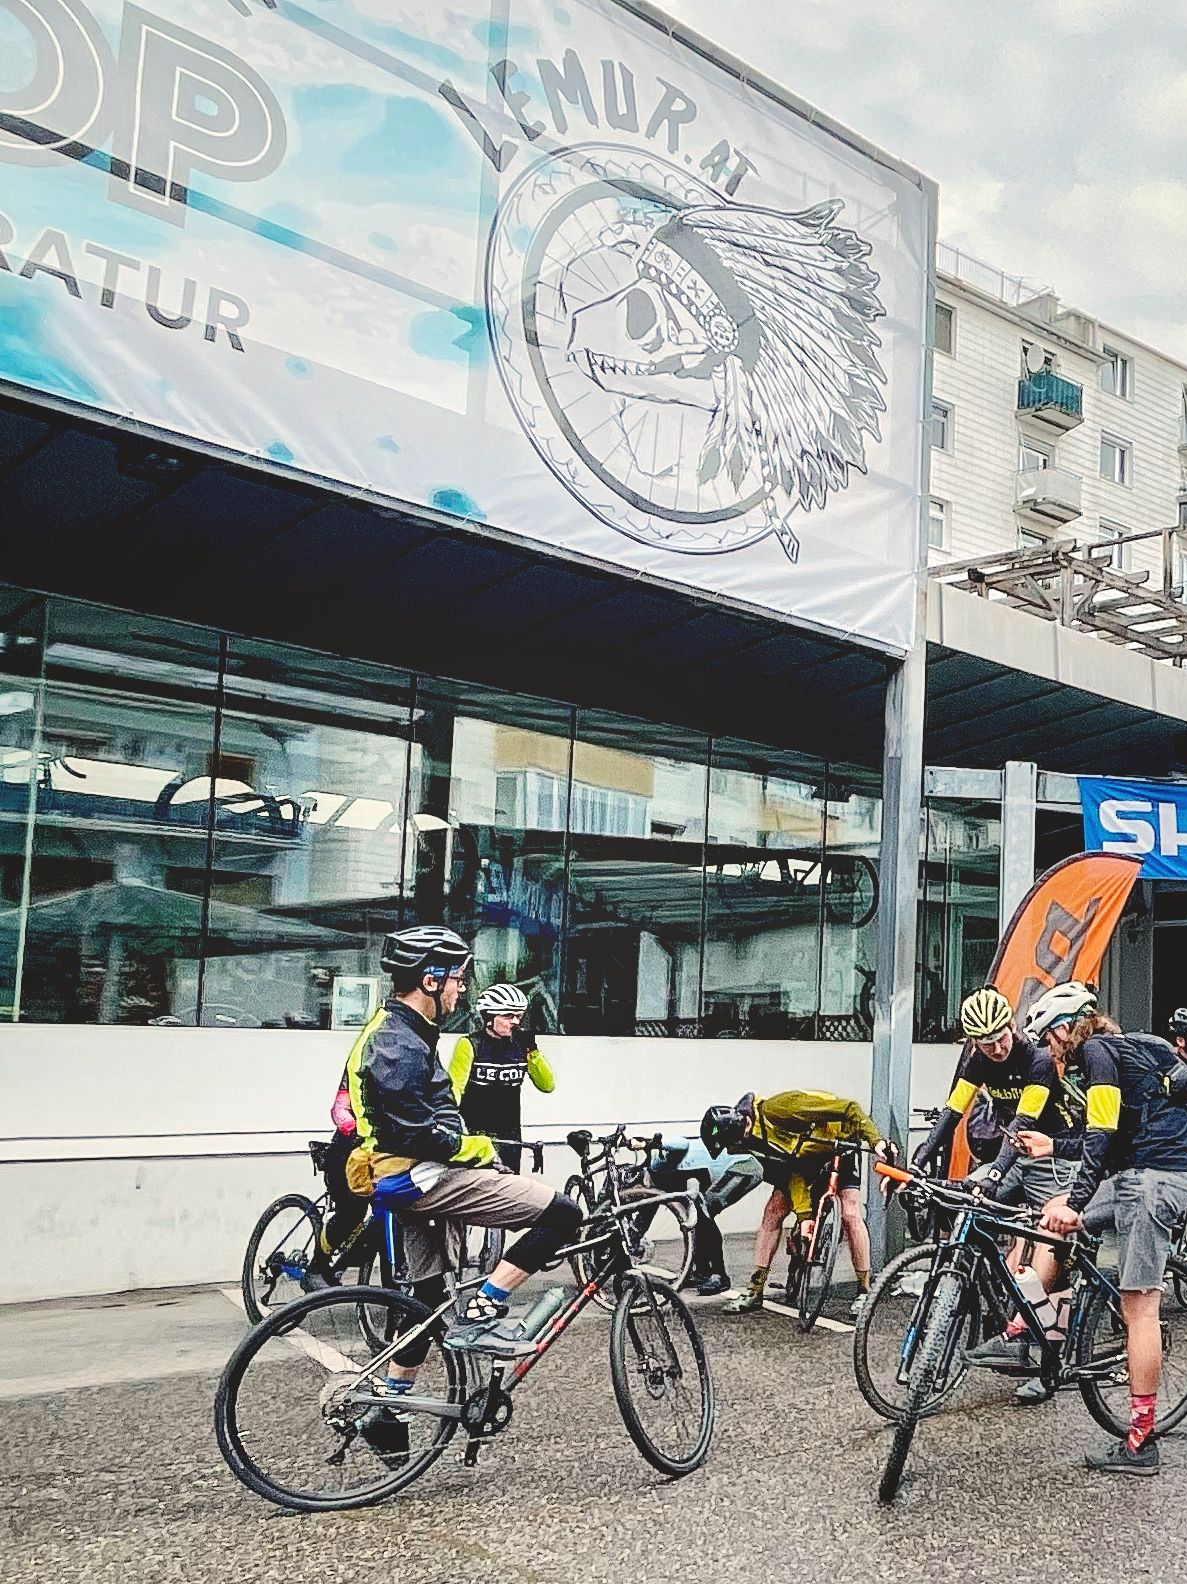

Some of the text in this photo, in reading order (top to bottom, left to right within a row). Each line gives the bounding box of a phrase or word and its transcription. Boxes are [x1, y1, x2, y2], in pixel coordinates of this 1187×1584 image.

[438, 47, 761, 197] LEMUR.AT
[0, 211, 250, 353] ATUR
[476, 1067, 496, 1081] LE
